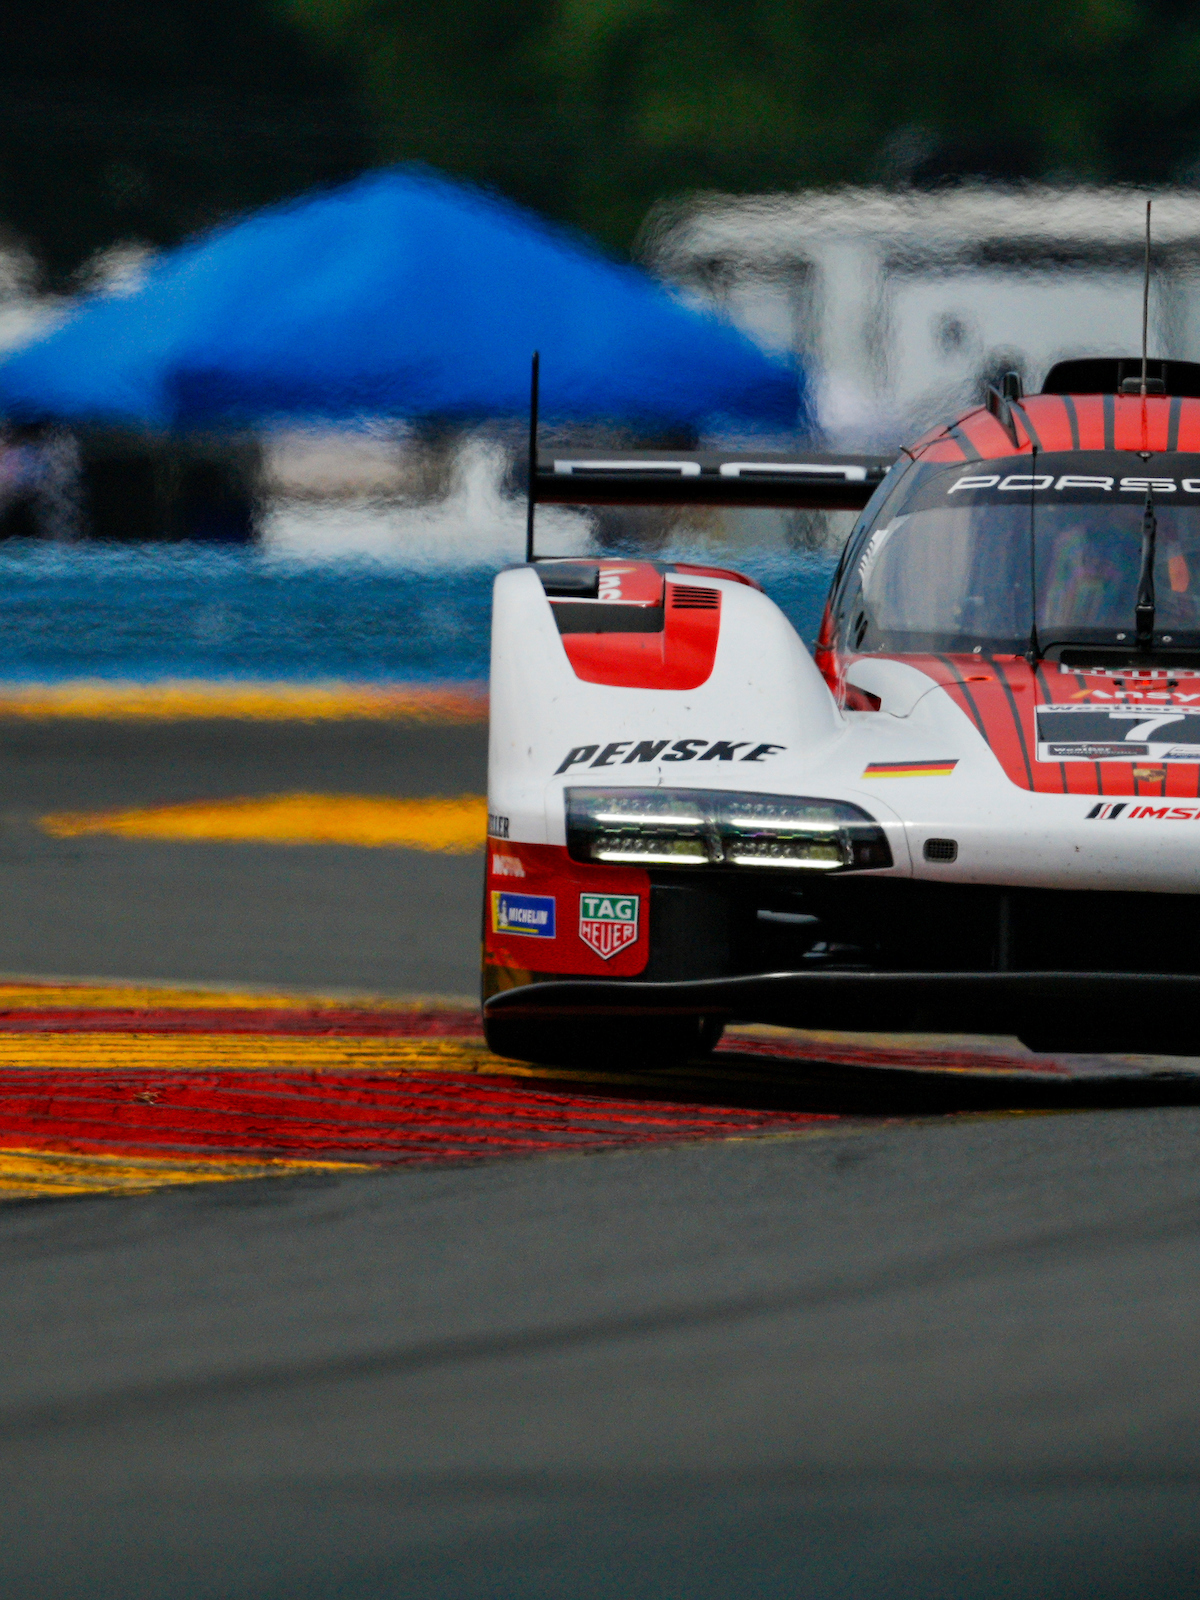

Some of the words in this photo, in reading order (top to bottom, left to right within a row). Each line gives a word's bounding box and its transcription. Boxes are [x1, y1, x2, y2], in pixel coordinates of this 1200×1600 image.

[1108, 712, 1186, 741] 7
[553, 739, 788, 775] PENSKE
[509, 907, 549, 925] MICHELIN
[583, 898, 632, 920] TAG
[581, 922, 634, 954] HEUER
